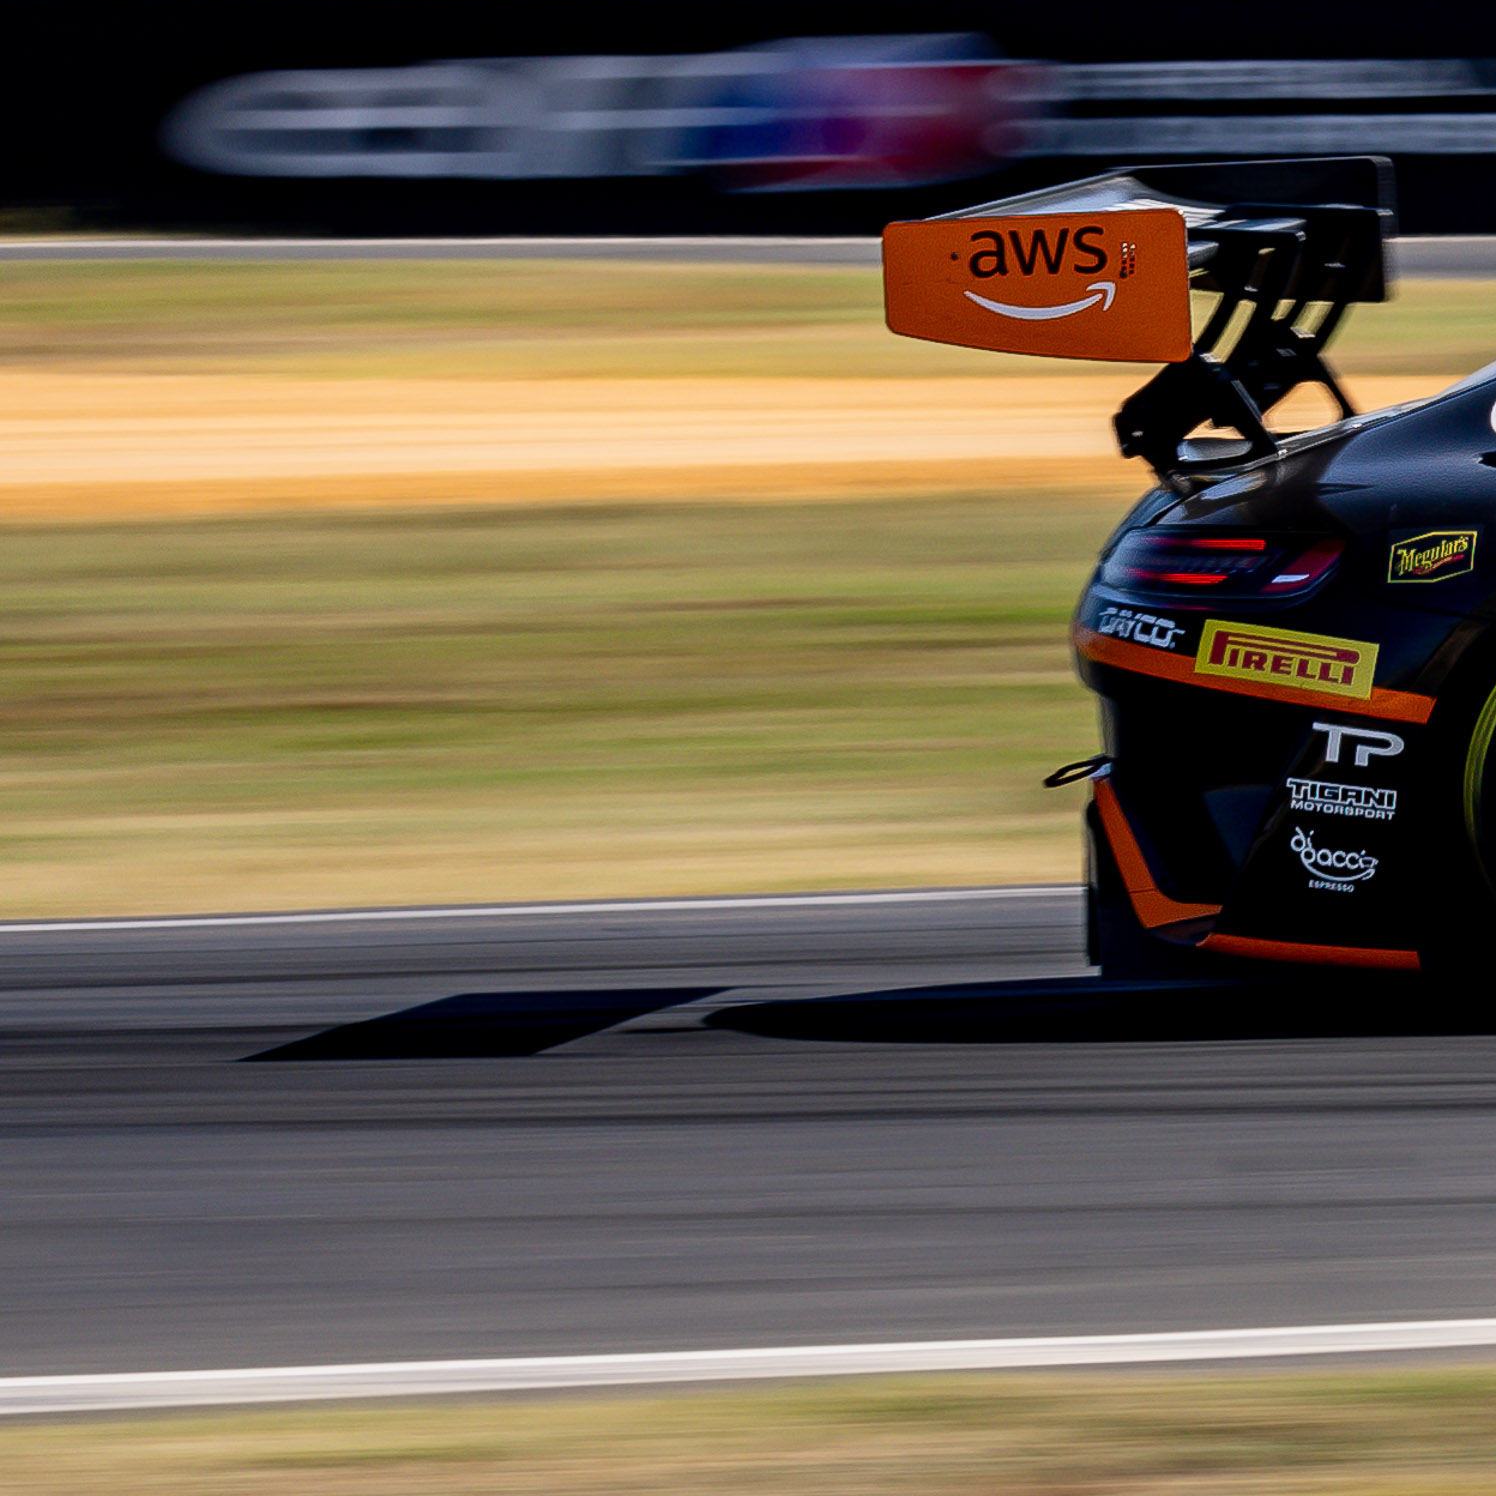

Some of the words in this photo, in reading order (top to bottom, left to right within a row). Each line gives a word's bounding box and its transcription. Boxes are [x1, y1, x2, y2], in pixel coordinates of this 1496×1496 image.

[969, 226, 1107, 278] aws
[1208, 630, 1361, 686] PIRELLI
[1312, 721, 1405, 767] TP
[1286, 777, 1397, 810] TIGANI
[1290, 799, 1396, 821] MOTORSPORT
